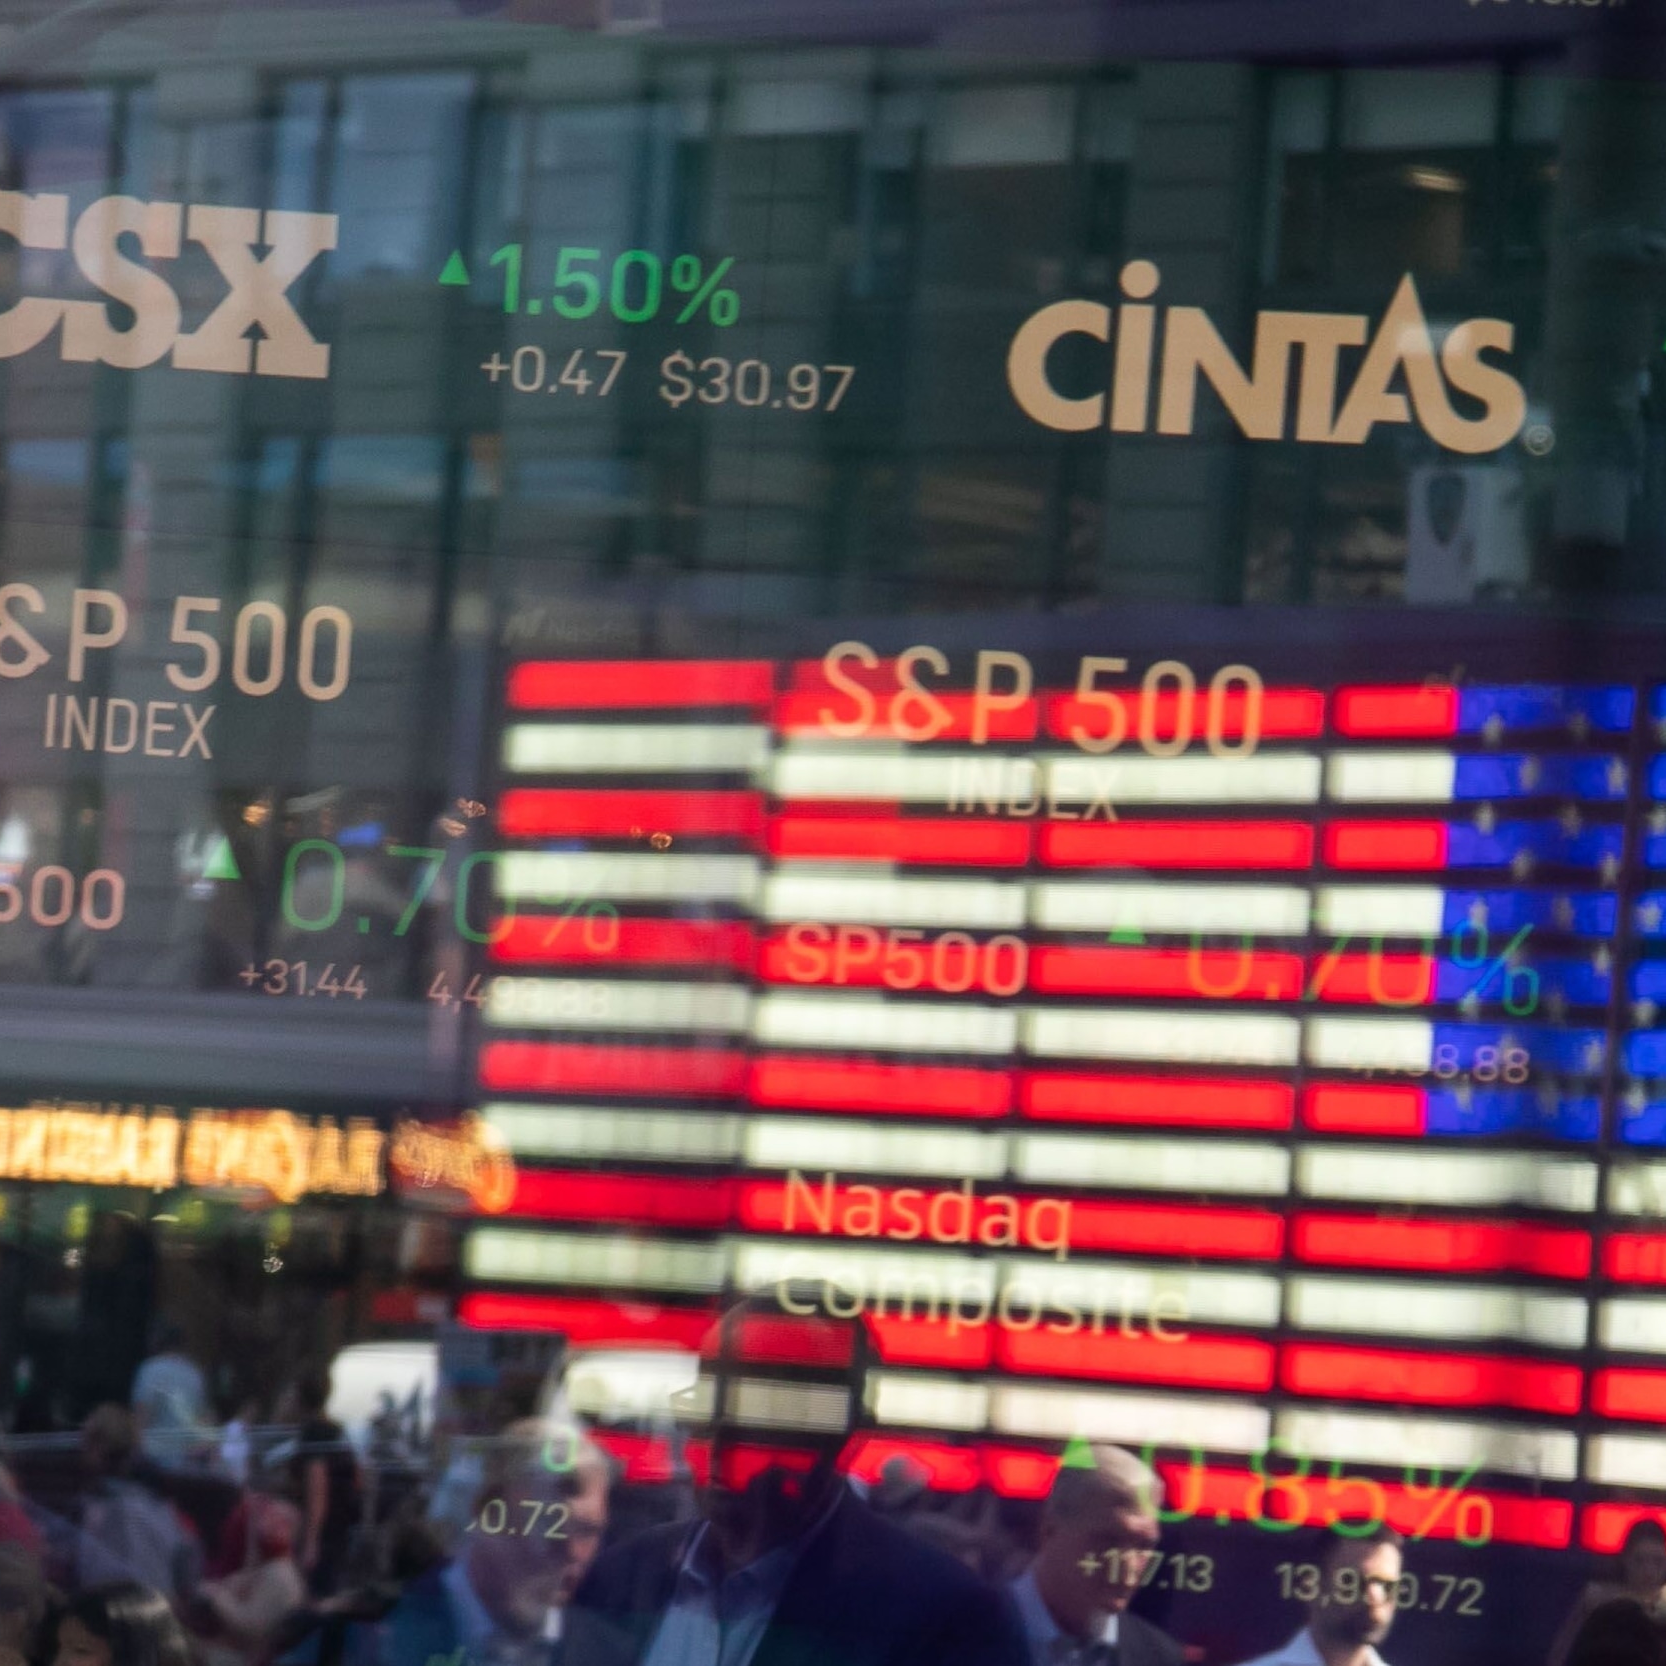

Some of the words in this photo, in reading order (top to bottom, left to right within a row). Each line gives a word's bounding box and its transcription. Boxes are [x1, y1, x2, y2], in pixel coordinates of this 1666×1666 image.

[489, 243, 741, 327] 1.50%
[480, 344, 628, 398] +0.47
[659, 349, 857, 413] $30.97
[164, 594, 354, 702] 500
[43, 693, 218, 760] INDEX
[818, 640, 1035, 744] S&P
[1069, 654, 1264, 758] 500
[946, 755, 1122, 824] INDEX
[239, 956, 368, 1001] +31.44
[782, 921, 1028, 997] SP500
[780, 1168, 1074, 1261] Nasdaq
[1076, 1548, 1215, 1593] +117.13
